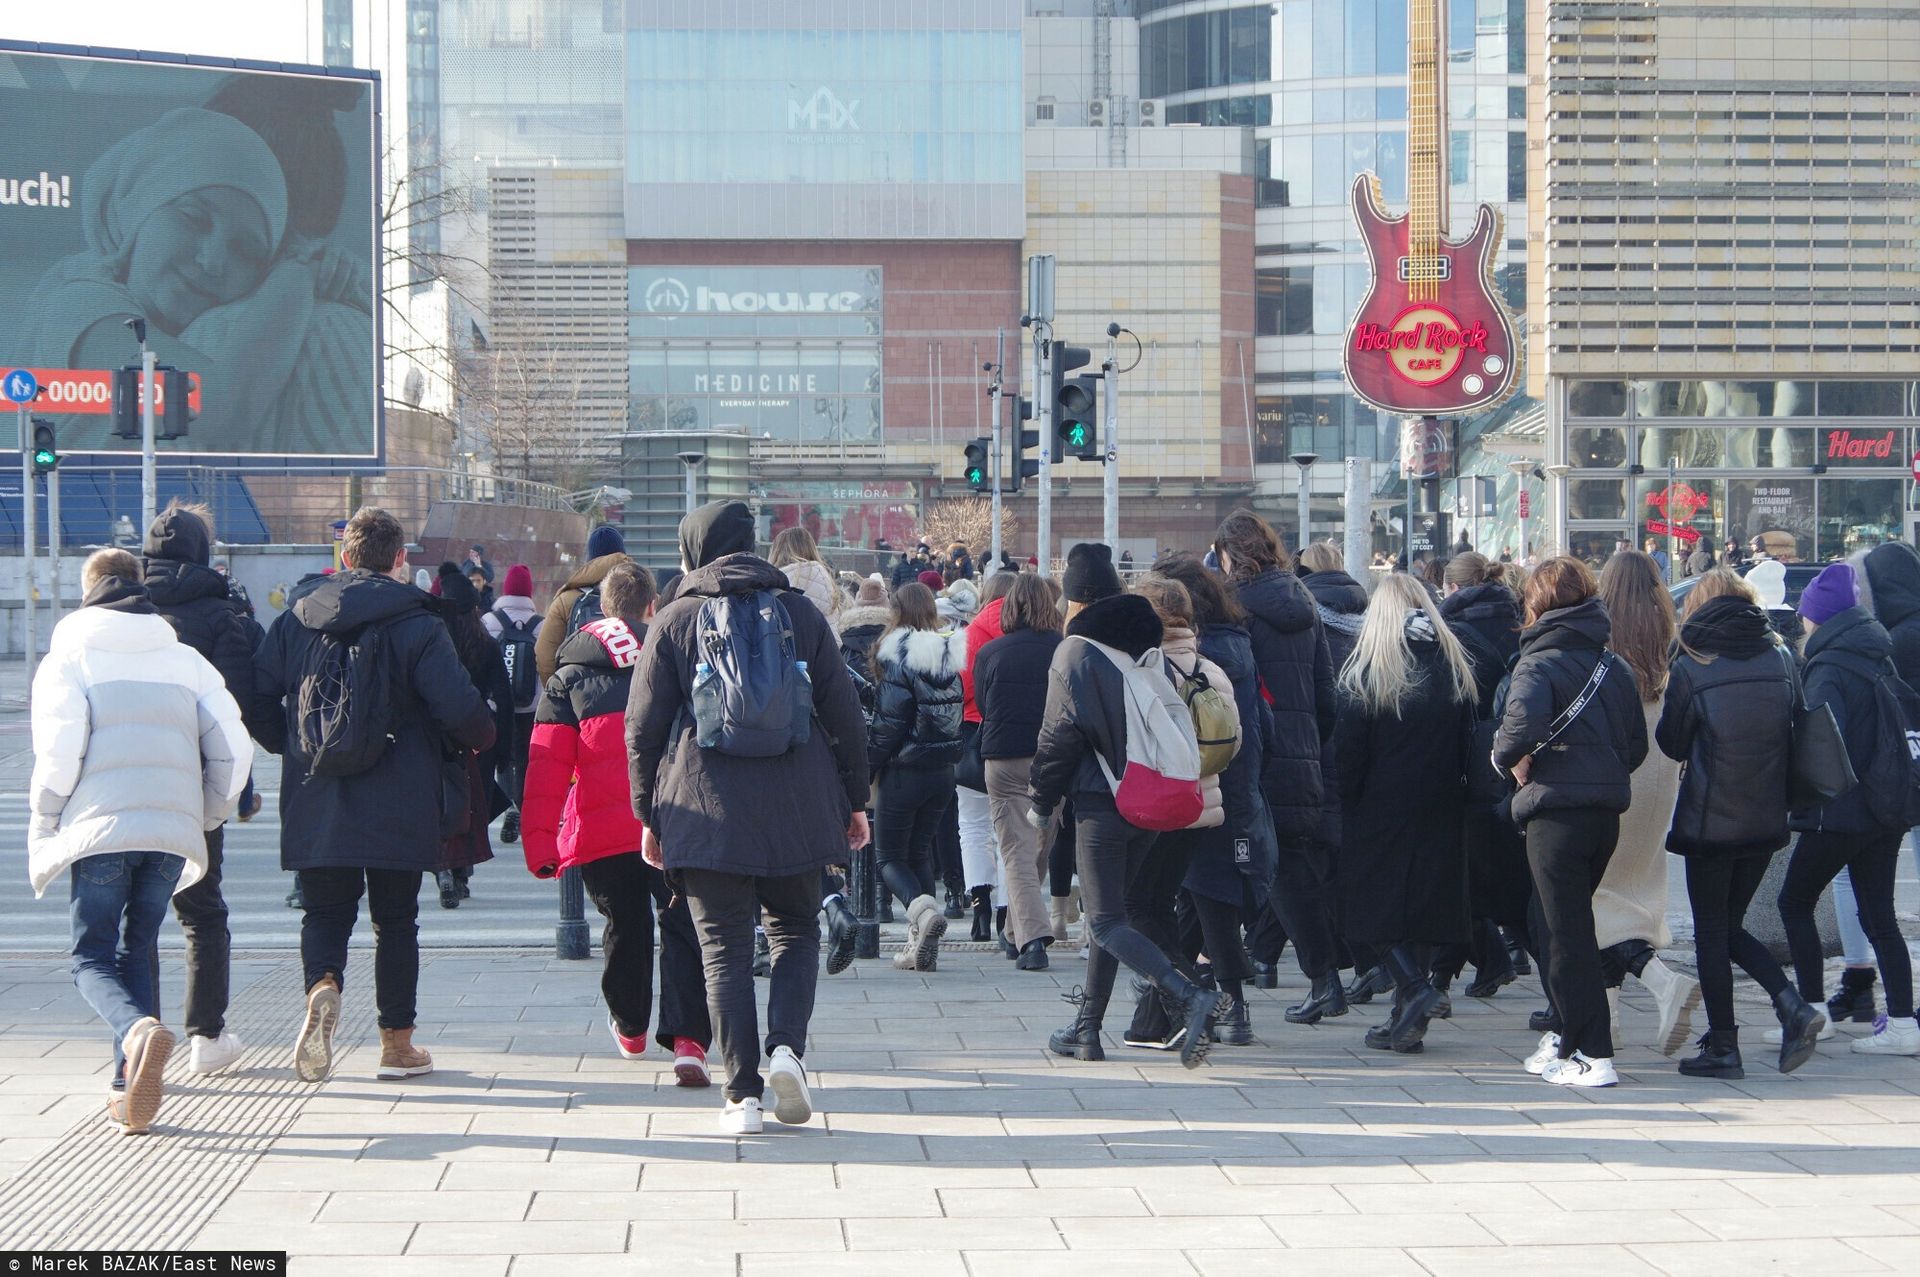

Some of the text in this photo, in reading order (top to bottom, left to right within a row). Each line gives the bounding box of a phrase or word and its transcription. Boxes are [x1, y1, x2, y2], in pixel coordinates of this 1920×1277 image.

[786, 86, 861, 129] MAX
[697, 286, 862, 312] house
[1356, 320, 1488, 354] Hard Rock
[1408, 358, 1442, 371] CAFE
[695, 374, 816, 392] MEDICINE
[720, 399, 790, 407] EVERYDAY THERAPY
[1827, 430, 1894, 458] Hard
[833, 488, 889, 498] SEPHORA
[1752, 497, 1792, 505] RESTAURANT
[1754, 487, 1791, 496] TWO-FLOOR
[1758, 506, 1786, 514] AND BAR
[503, 644, 516, 685] didas
[1592, 663, 1606, 684] JENNY
[1566, 696, 1586, 719] JENNY
